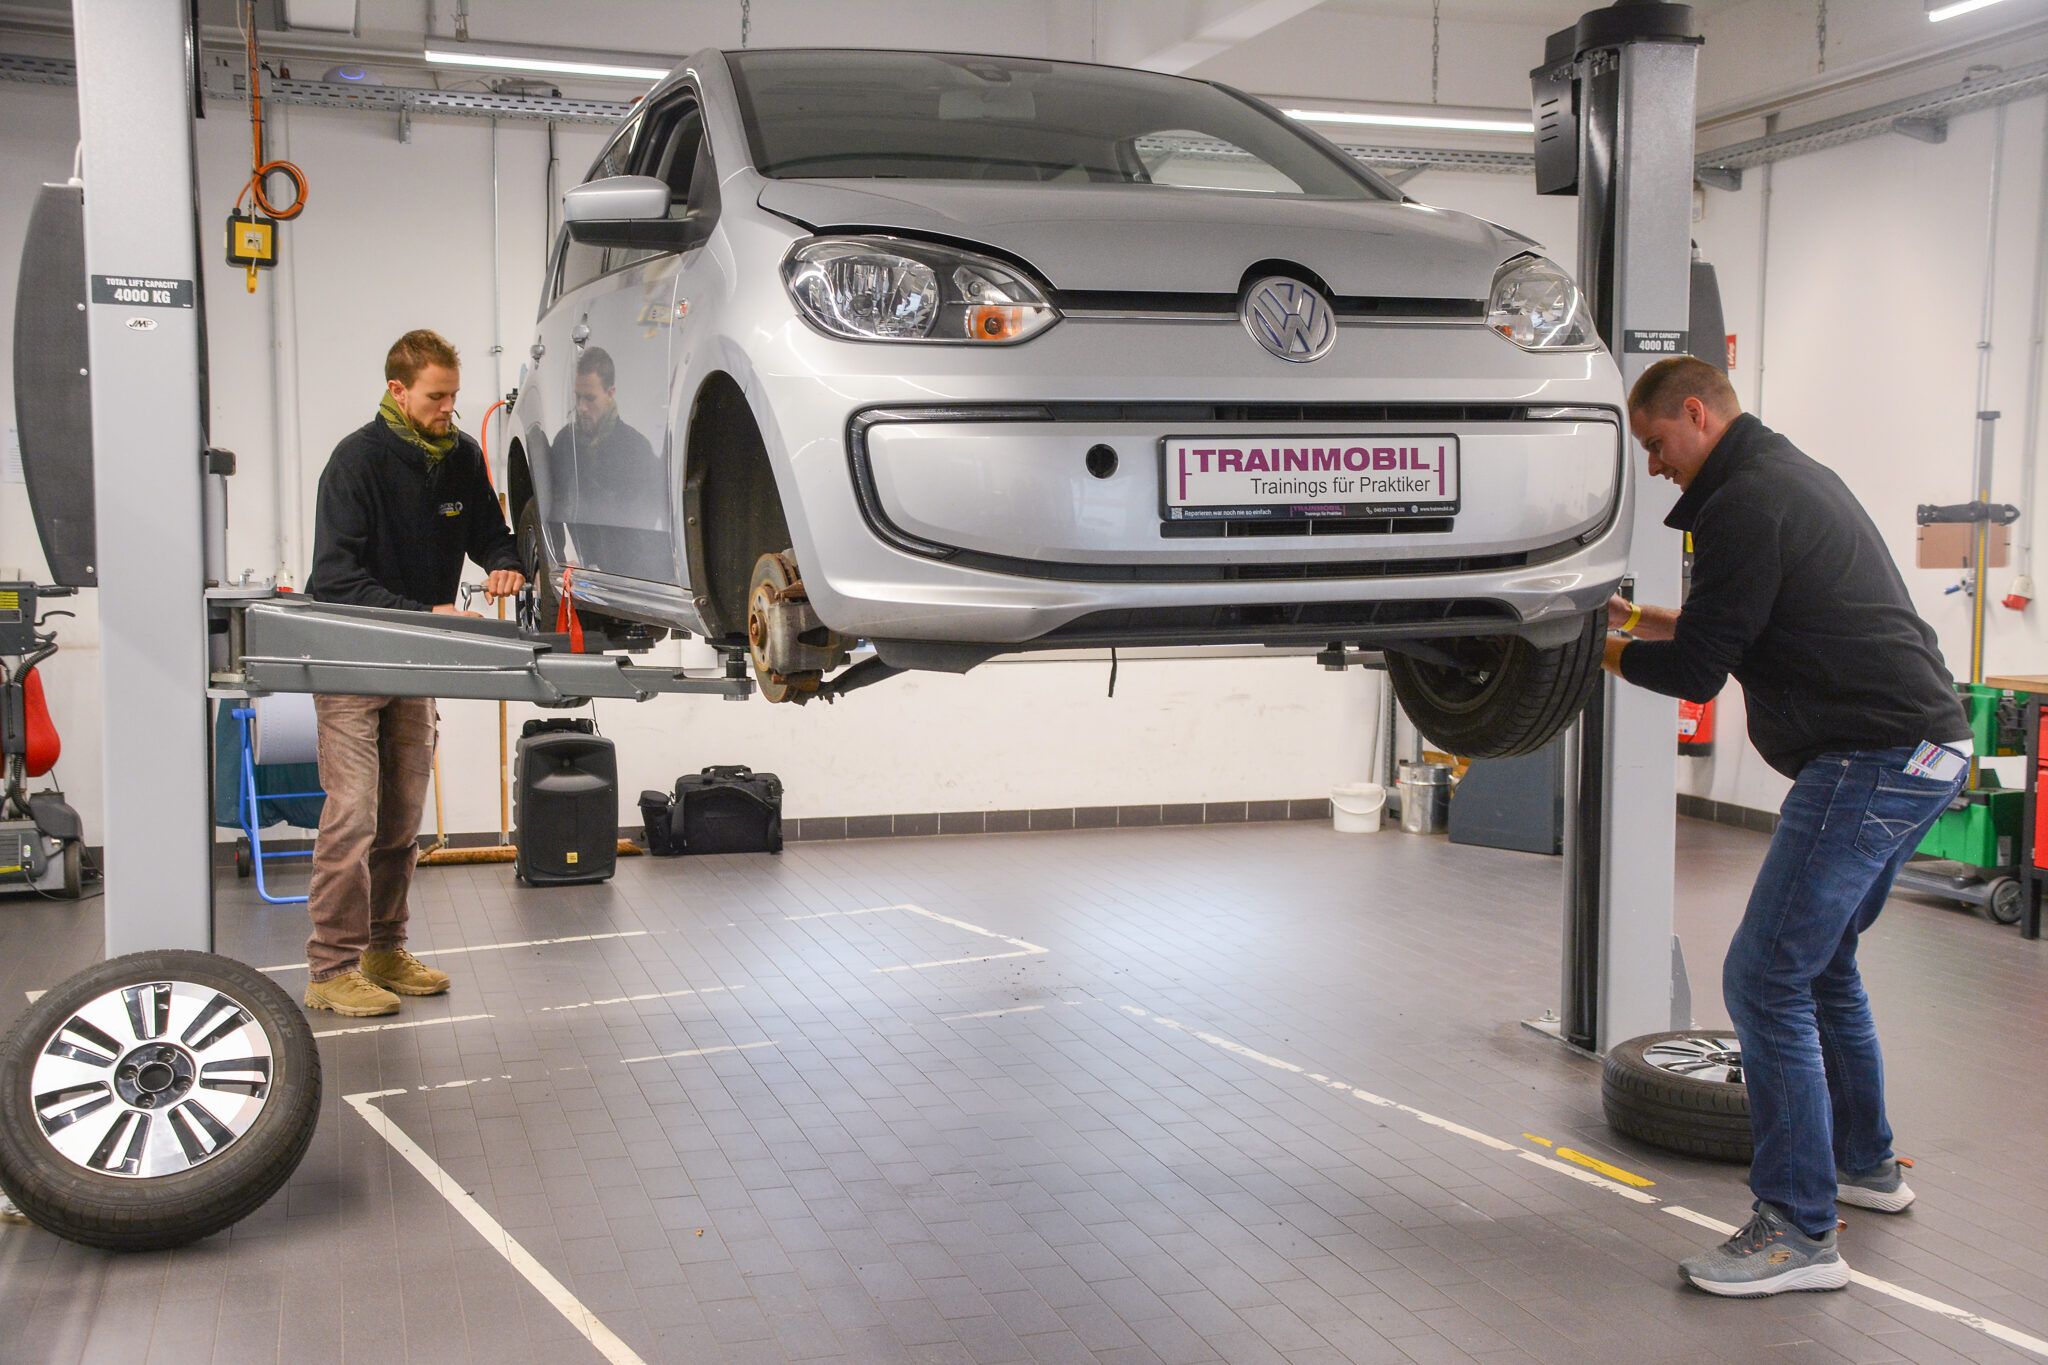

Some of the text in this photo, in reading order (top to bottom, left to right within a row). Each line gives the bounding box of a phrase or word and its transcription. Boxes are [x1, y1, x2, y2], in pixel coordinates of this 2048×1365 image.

[106, 278, 178, 289] TOTAL LIFT CAPACITY
[114, 288, 171, 304] 4000 KG
[1639, 340, 1675, 350] 4000 KG
[1192, 447, 1430, 473] TRAINMOBIL
[1250, 475, 1430, 497] Trainings für Praktiker
[228, 972, 292, 1038] DUNLOP
